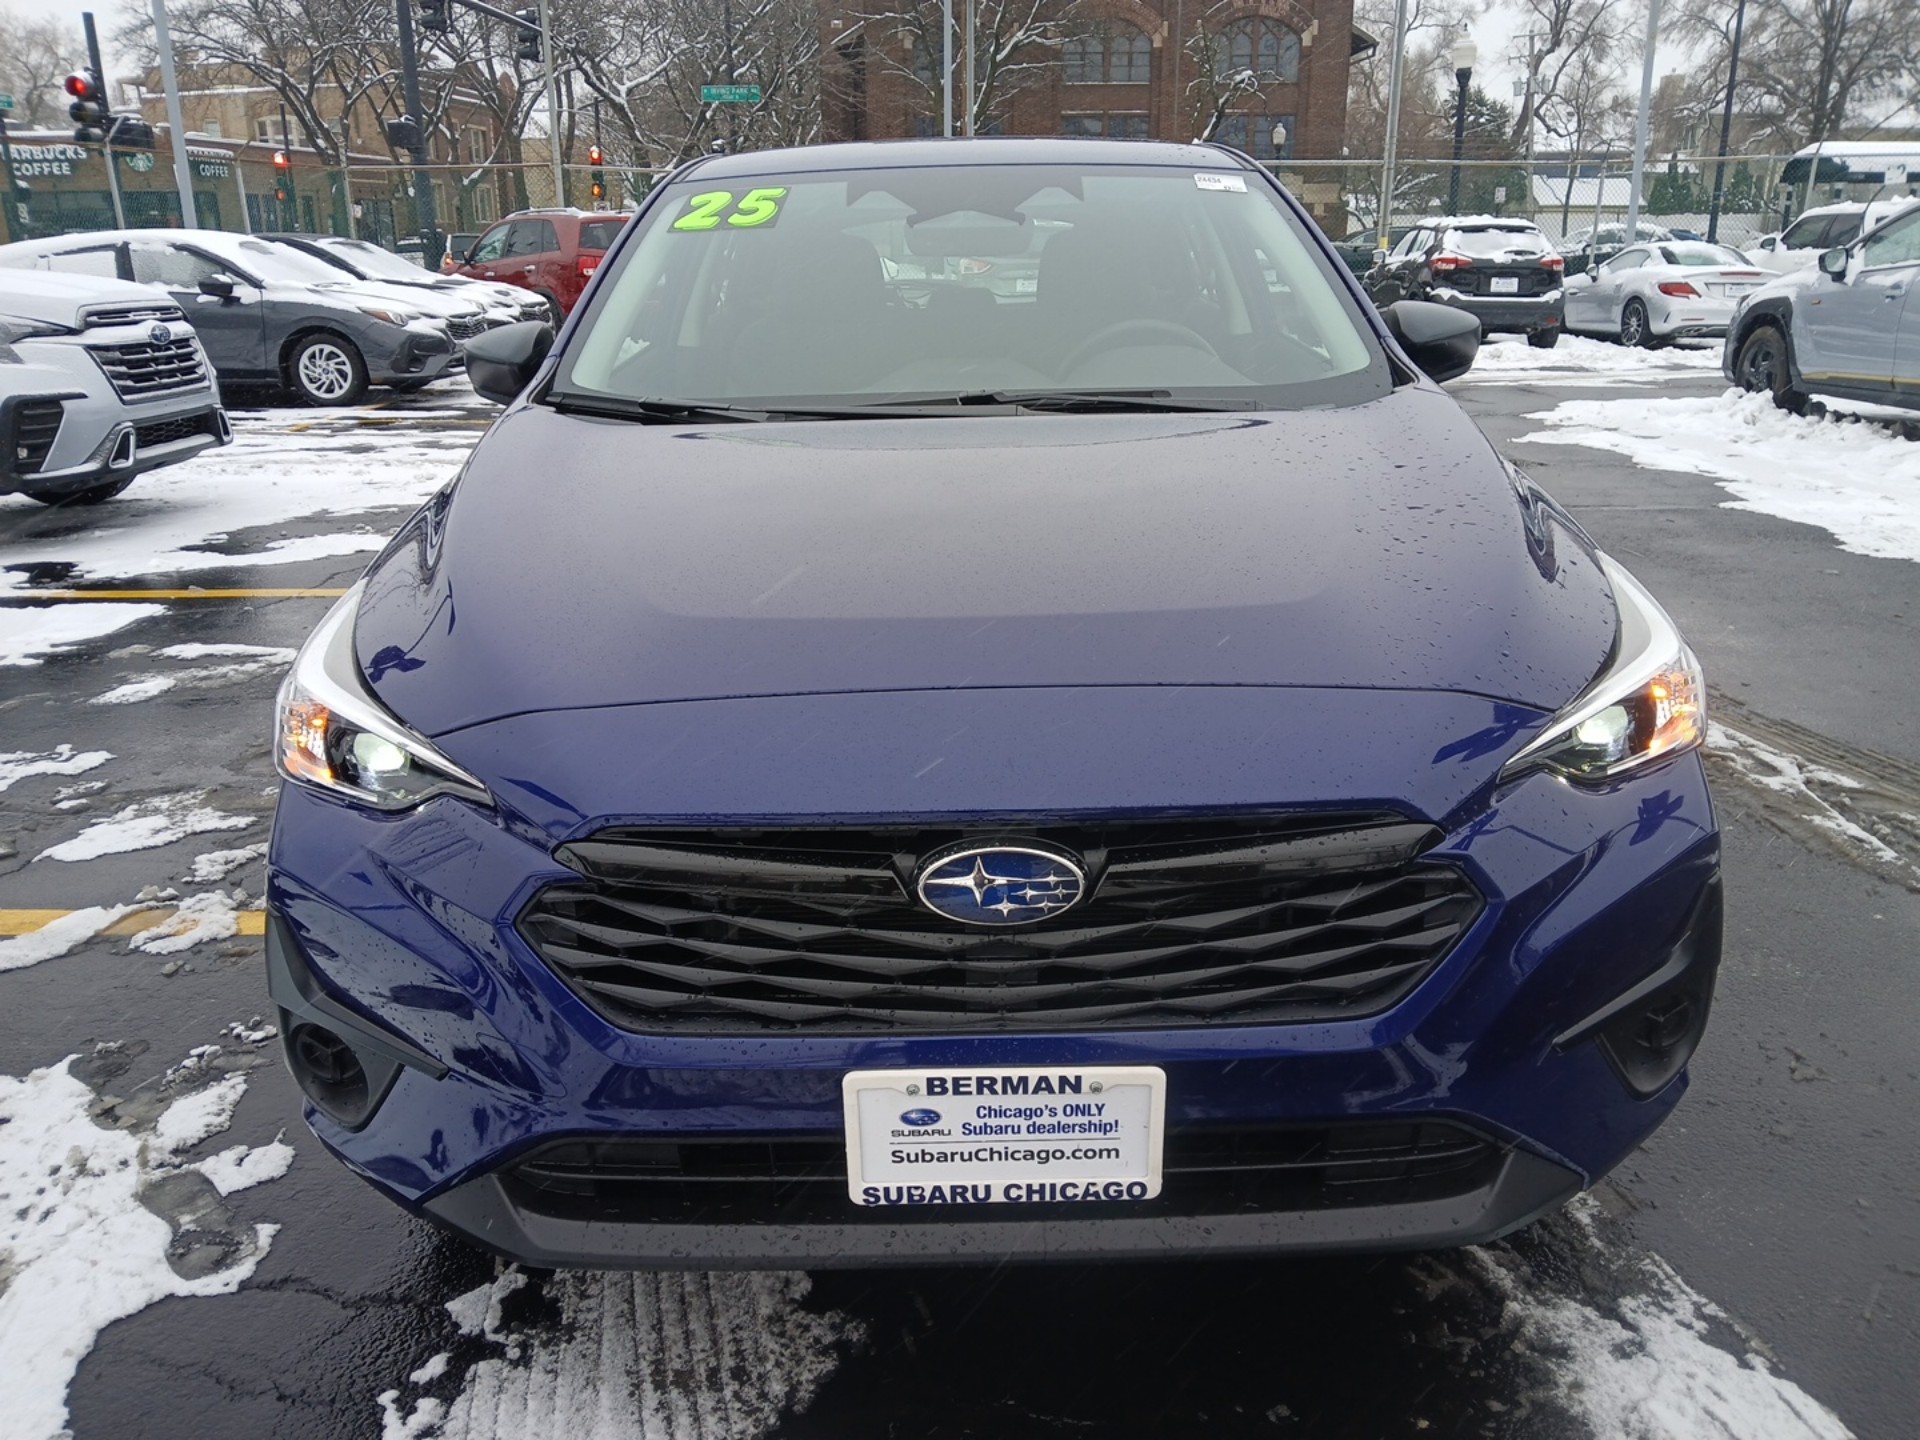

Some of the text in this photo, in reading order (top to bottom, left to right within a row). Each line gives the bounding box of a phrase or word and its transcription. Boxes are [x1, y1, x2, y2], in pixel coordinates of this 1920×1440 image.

[12, 161, 72, 176] COFFEE
[199, 164, 230, 178] COFFEE
[673, 187, 787, 231] 25
[925, 1075, 1083, 1096] BERMAN
[976, 1103, 1106, 1121] Chicago's ONLY
[891, 1129, 951, 1138] SUBARU
[961, 1120, 1119, 1136] Subaru dealership!
[891, 1147, 1120, 1165] SubaruChicago.com
[862, 1181, 1148, 1206] SUBARU CHICAGO
